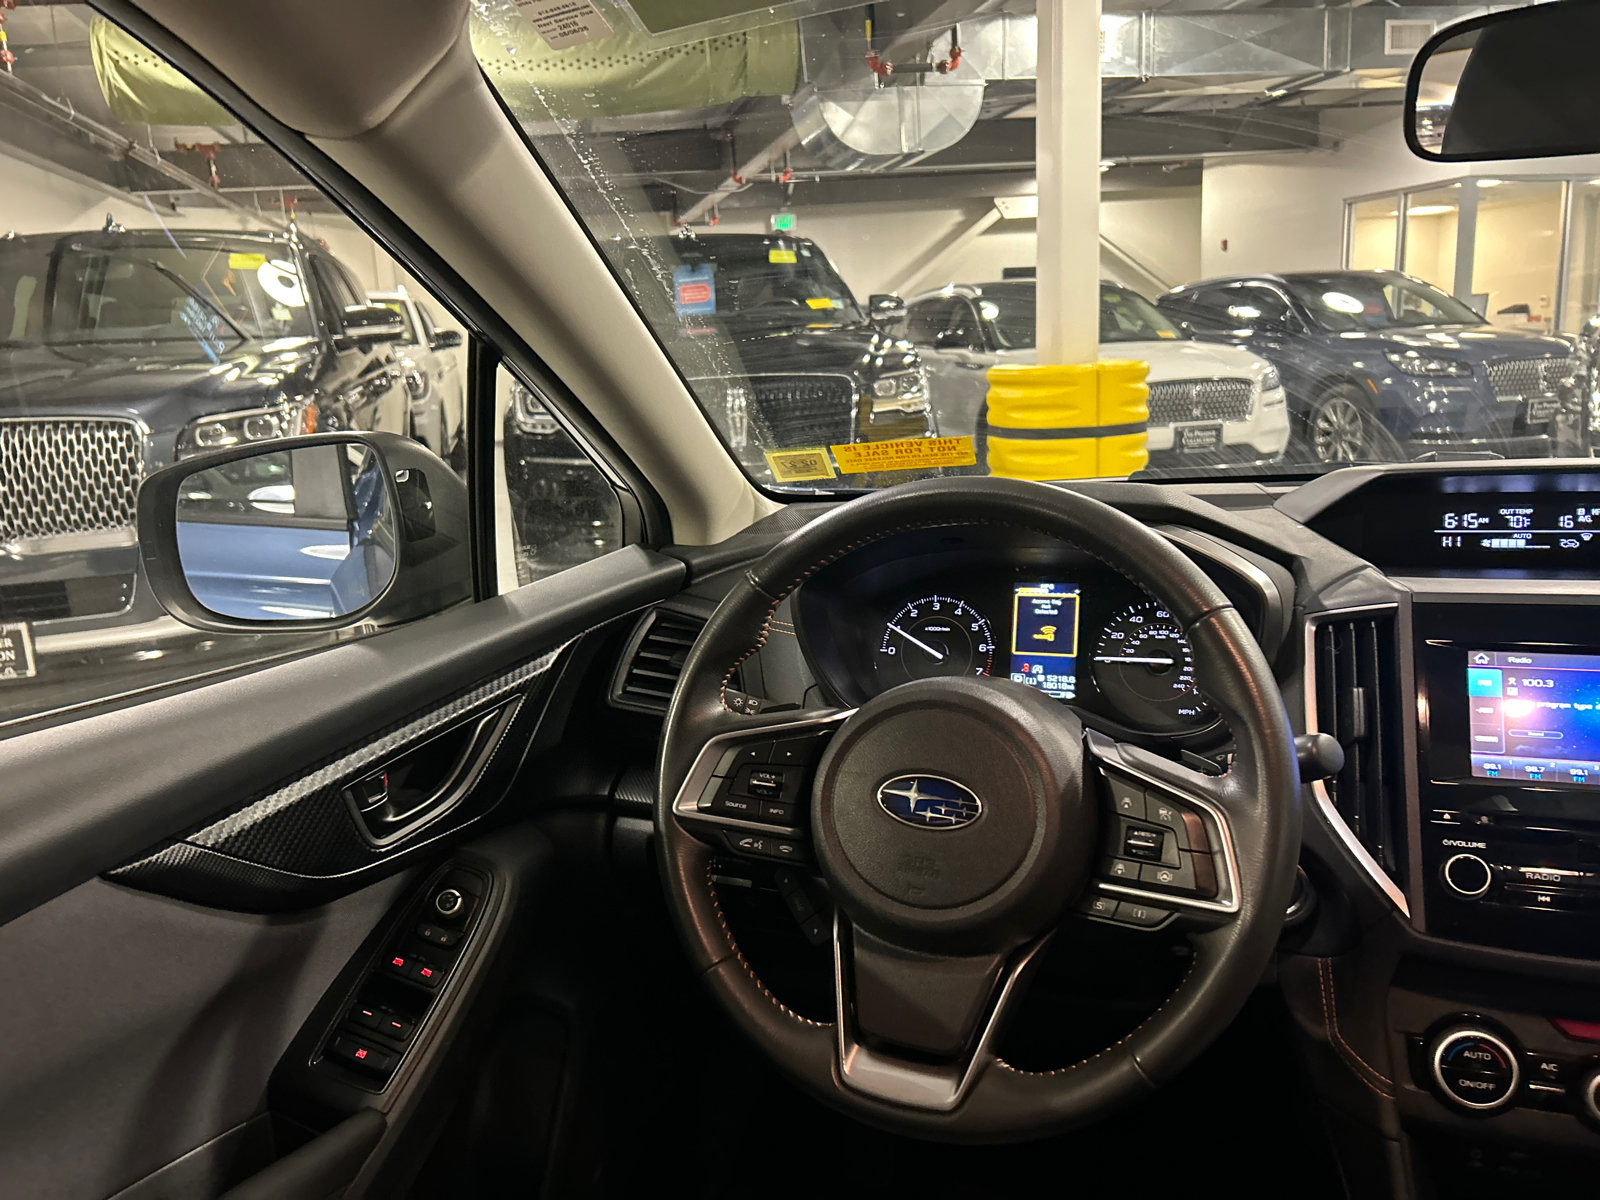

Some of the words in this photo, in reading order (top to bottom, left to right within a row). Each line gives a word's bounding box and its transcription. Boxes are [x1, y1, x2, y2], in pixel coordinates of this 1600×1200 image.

[537, 19, 553, 28] Next
[555, 14, 579, 24] Service
[1443, 512, 1479, 529] 6:15
[1558, 514, 1574, 528] 16
[932, 602, 940, 611] 3
[910, 608, 918, 617] 2
[954, 607, 962, 616] 4
[970, 623, 979, 632] 5
[887, 646, 896, 655] 0
[978, 643, 987, 652] 6
[1507, 656, 1533, 664] Radio
[975, 667, 983, 675] 7
[1046, 674, 1077, 683] 5218.6
[1521, 678, 1554, 688] 100.3
[1573, 702, 1593, 711] type
[1569, 768, 1588, 776] 99.1
[1525, 872, 1561, 882] RADIO
[1463, 1050, 1492, 1061] AUTO
[1540, 1062, 1559, 1071] A/C
[1457, 1078, 1496, 1091] ON/OFF
